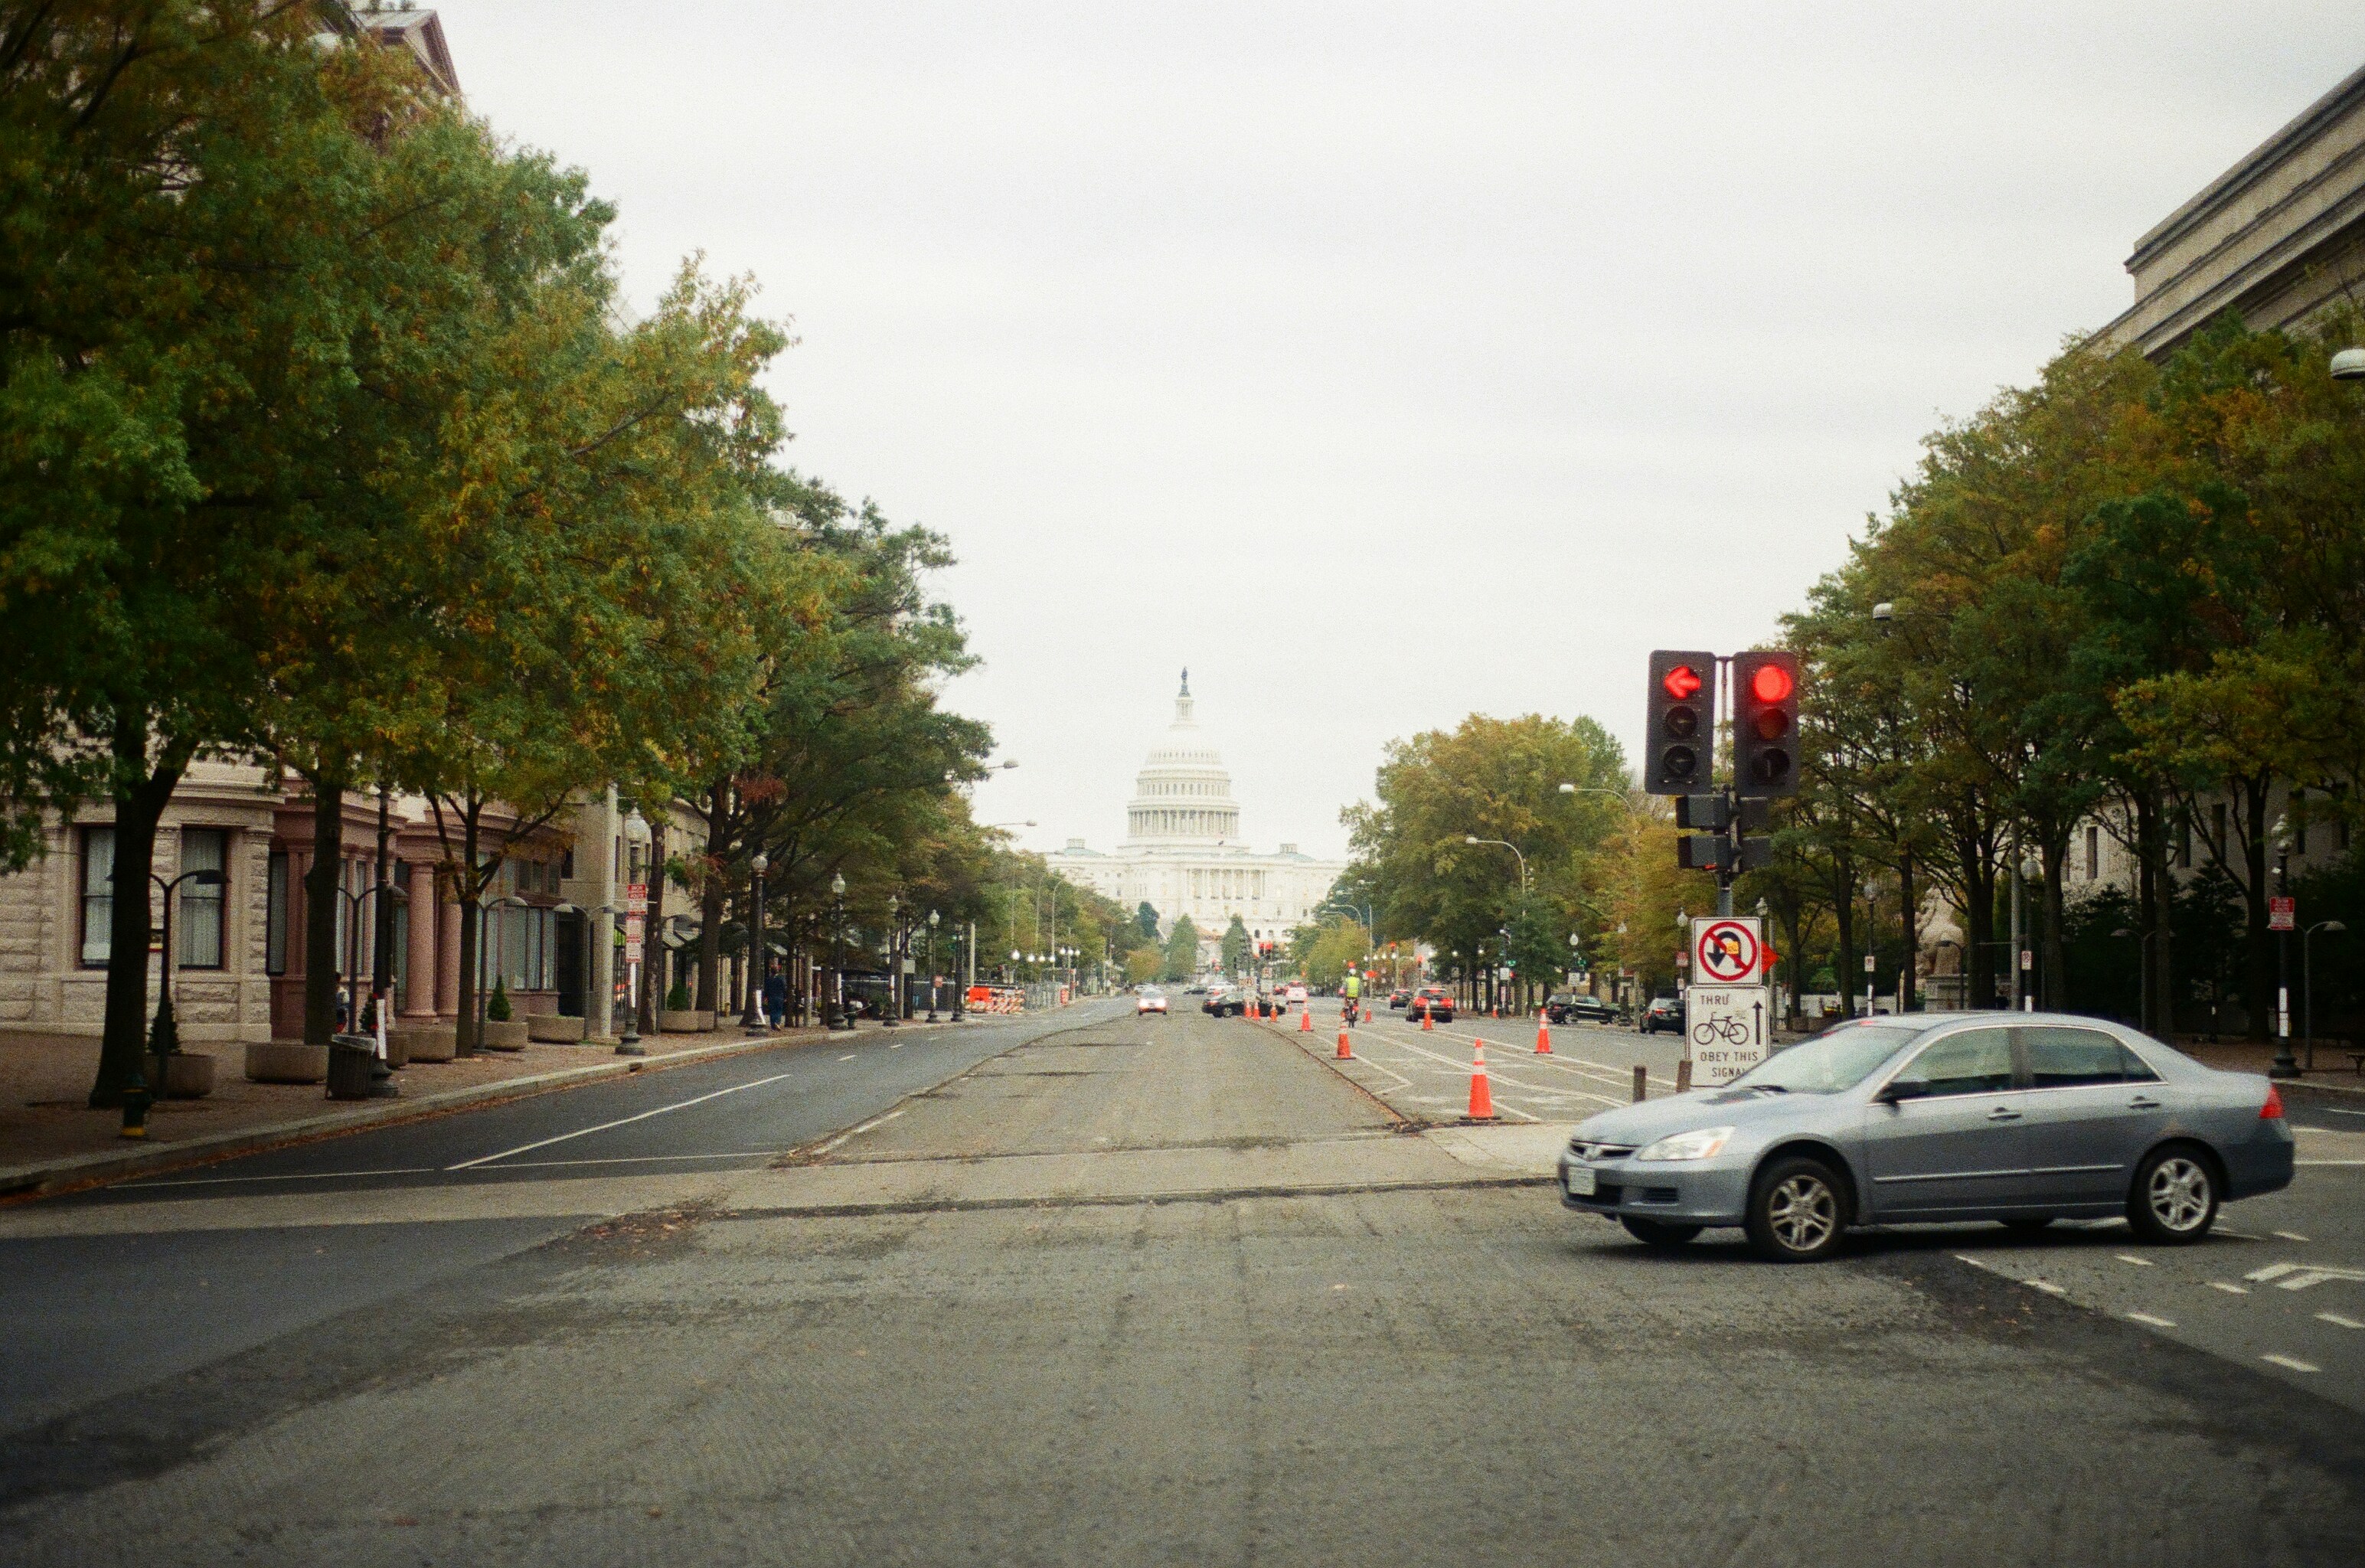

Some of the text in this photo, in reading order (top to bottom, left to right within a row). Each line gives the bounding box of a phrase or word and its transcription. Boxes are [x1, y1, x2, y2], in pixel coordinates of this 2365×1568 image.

[1700, 995, 1730, 1004] THRU
[1700, 1052, 1758, 1061] OBEY THIS
